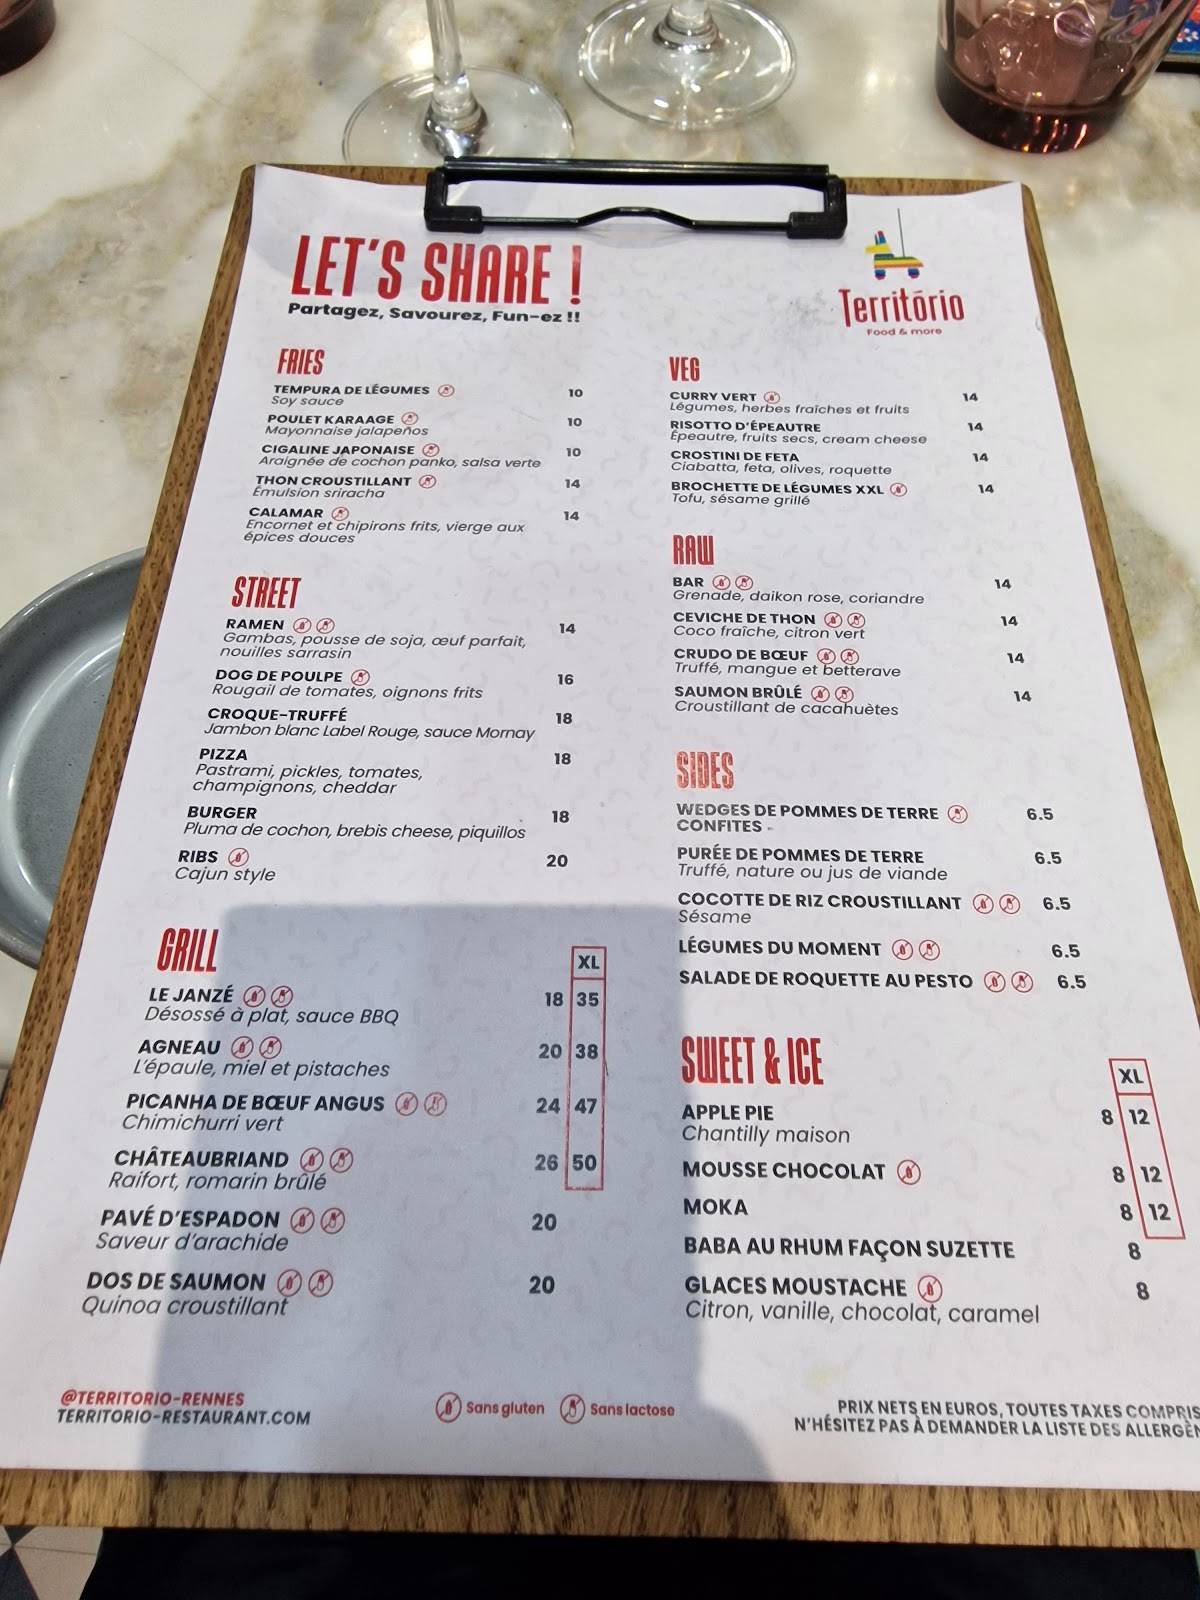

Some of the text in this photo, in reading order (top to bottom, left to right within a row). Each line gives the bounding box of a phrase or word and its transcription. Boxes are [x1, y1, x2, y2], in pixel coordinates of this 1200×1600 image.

[290, 234, 583, 306] LET'S SHARE !
[287, 302, 384, 320] Partagez,
[389, 307, 487, 323] Savourez,
[567, 311, 580, 323] !!
[866, 328, 896, 336] Food
[899, 328, 908, 336] &
[276, 348, 325, 376] FRIES
[669, 356, 700, 382] VEG
[274, 383, 430, 395] TEMPURA DE LÉGUMES
[568, 388, 584, 398] 10
[271, 395, 344, 408] Soy sauce
[670, 419, 821, 433] RISOTTO D'ÉPEAUTRE
[967, 422, 984, 432] 14
[670, 429, 927, 445] Épeautre, fruits secs, cream cheese
[261, 444, 415, 456] CIGALINE JAPONAISE
[566, 447, 582, 457] 10
[258, 454, 541, 470] Araignée de cochon panko, salsa verte
[671, 481, 885, 495] BROCHETTE DE LÉGUMES XXL
[978, 484, 994, 494] 14
[672, 492, 810, 508] Tofu, sésame grillé
[672, 534, 715, 566] RAW
[672, 576, 704, 588] BAR
[994, 578, 1012, 590] 14
[231, 575, 302, 609] STREET
[673, 589, 925, 605] Grenade, daikon rose, coriandre
[225, 618, 285, 631] RAMEN
[559, 623, 576, 634] 14
[222, 631, 527, 650] Gambas, pousse de soja, œuf parfait,
[219, 645, 352, 659] nouilles sarrasin
[673, 648, 809, 662] CRUDO DE BŒUF
[1006, 652, 1025, 664] 14
[675, 661, 902, 678] Truffé, mangue et betterave
[207, 706, 348, 722] CROQUE-TRUFFÉ
[555, 712, 573, 725] 18
[204, 722, 536, 743] Jambon blanc Label Rouge, sauce Mornay
[676, 751, 734, 790] SIDES
[676, 803, 939, 820] WEDGES DE POMMES DE TERRE
[1026, 807, 1054, 821] 6.5
[676, 818, 762, 833] CONFITES
[677, 892, 962, 910] COCOTTE DE RIZ CROUSTILLANT
[1042, 896, 1071, 911] 6.5
[678, 908, 752, 924] Sésame
[156, 927, 219, 973] GRILL
[577, 954, 600, 970] XL
[148, 984, 235, 1003] LE JANZÉ
[544, 991, 564, 1007] 18
[576, 991, 599, 1008] 35
[144, 1005, 399, 1027] Désossé à plat, sauce BBQ
[681, 1035, 825, 1086] SWEET & ICE
[1118, 1068, 1145, 1084] XL
[126, 1093, 385, 1112] PICANHA DE BŒUF ANGUS
[536, 1097, 561, 1114] 24
[574, 1097, 598, 1115] 47
[122, 1113, 284, 1132] Chimichurri vert
[682, 1160, 886, 1180] MOUSSE CHOCOLAT
[1112, 1165, 1126, 1184] 8
[1140, 1165, 1163, 1183] 12
[100, 1204, 281, 1229] PAVÉ D'ESPADON
[531, 1212, 557, 1232] 20
[95, 1231, 289, 1252] Saveur d'arachide
[684, 1236, 1016, 1263] BABA AU RHUM FAÇON SUZETTE
[1127, 1242, 1142, 1261] 8
[60, 1388, 245, 1407] @TERRITORIO-RENNES
[56, 1408, 312, 1426] TERRITORIO-RESTAURANT.COM
[466, 1401, 545, 1419] Sans gluten
[590, 1402, 675, 1417] Sans lactose
[838, 1399, 874, 1414] PRIX
[877, 1400, 918, 1416] NETS
[921, 1401, 942, 1416] EN
[945, 1401, 1003, 1419] EUROS,
[1005, 1402, 1068, 1418] TOUTES
[1070, 1403, 1123, 1418] TAXES
[794, 1413, 1121, 1437] N'HÉSITEZ PAS À DEMANDER LA LISTE DES
